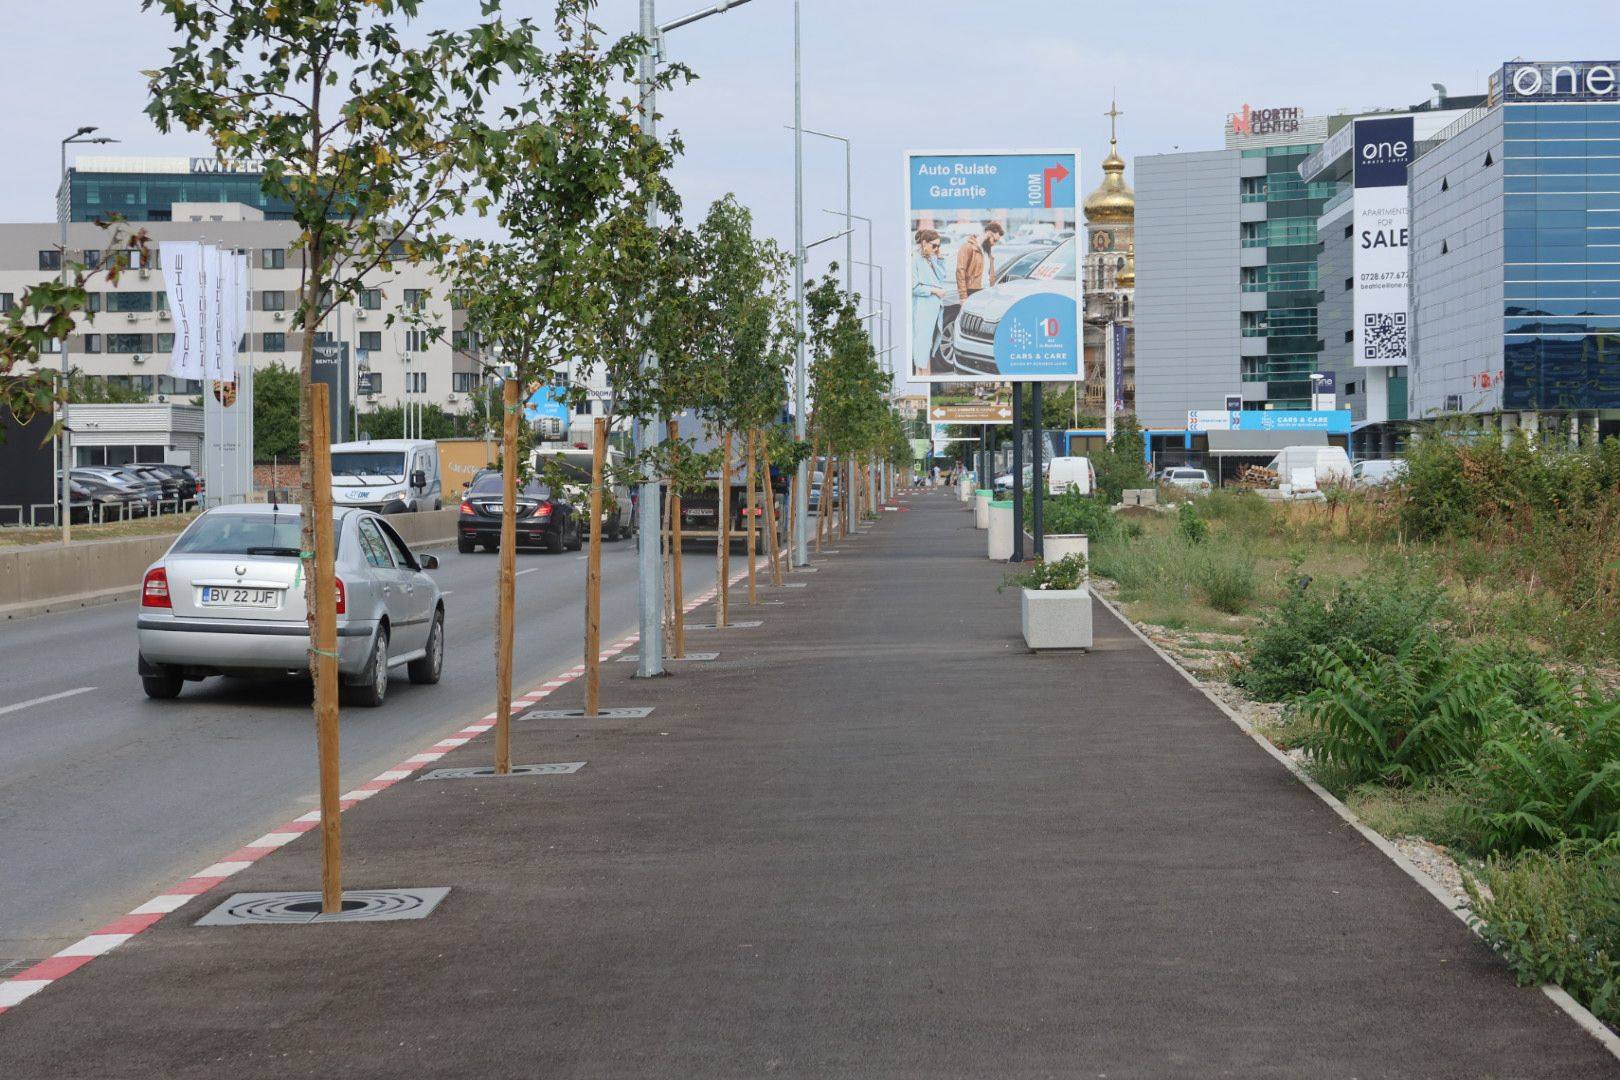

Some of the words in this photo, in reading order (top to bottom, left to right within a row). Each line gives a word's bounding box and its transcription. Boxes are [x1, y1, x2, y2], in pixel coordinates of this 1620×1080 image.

[1513, 65, 1615, 95] one
[1251, 107, 1298, 121] NORTH
[1251, 119, 1299, 134] CENTER
[1362, 141, 1408, 159] one
[918, 164, 951, 175] Auto
[954, 163, 998, 175] Rulate
[949, 177, 966, 186] cu
[1028, 173, 1042, 206] 100M
[1377, 219, 1393, 227] FOR
[1361, 228, 1409, 250] SALE
[210, 589, 229, 602] BV
[233, 590, 249, 602] 22
[252, 591, 275, 604] JJF
